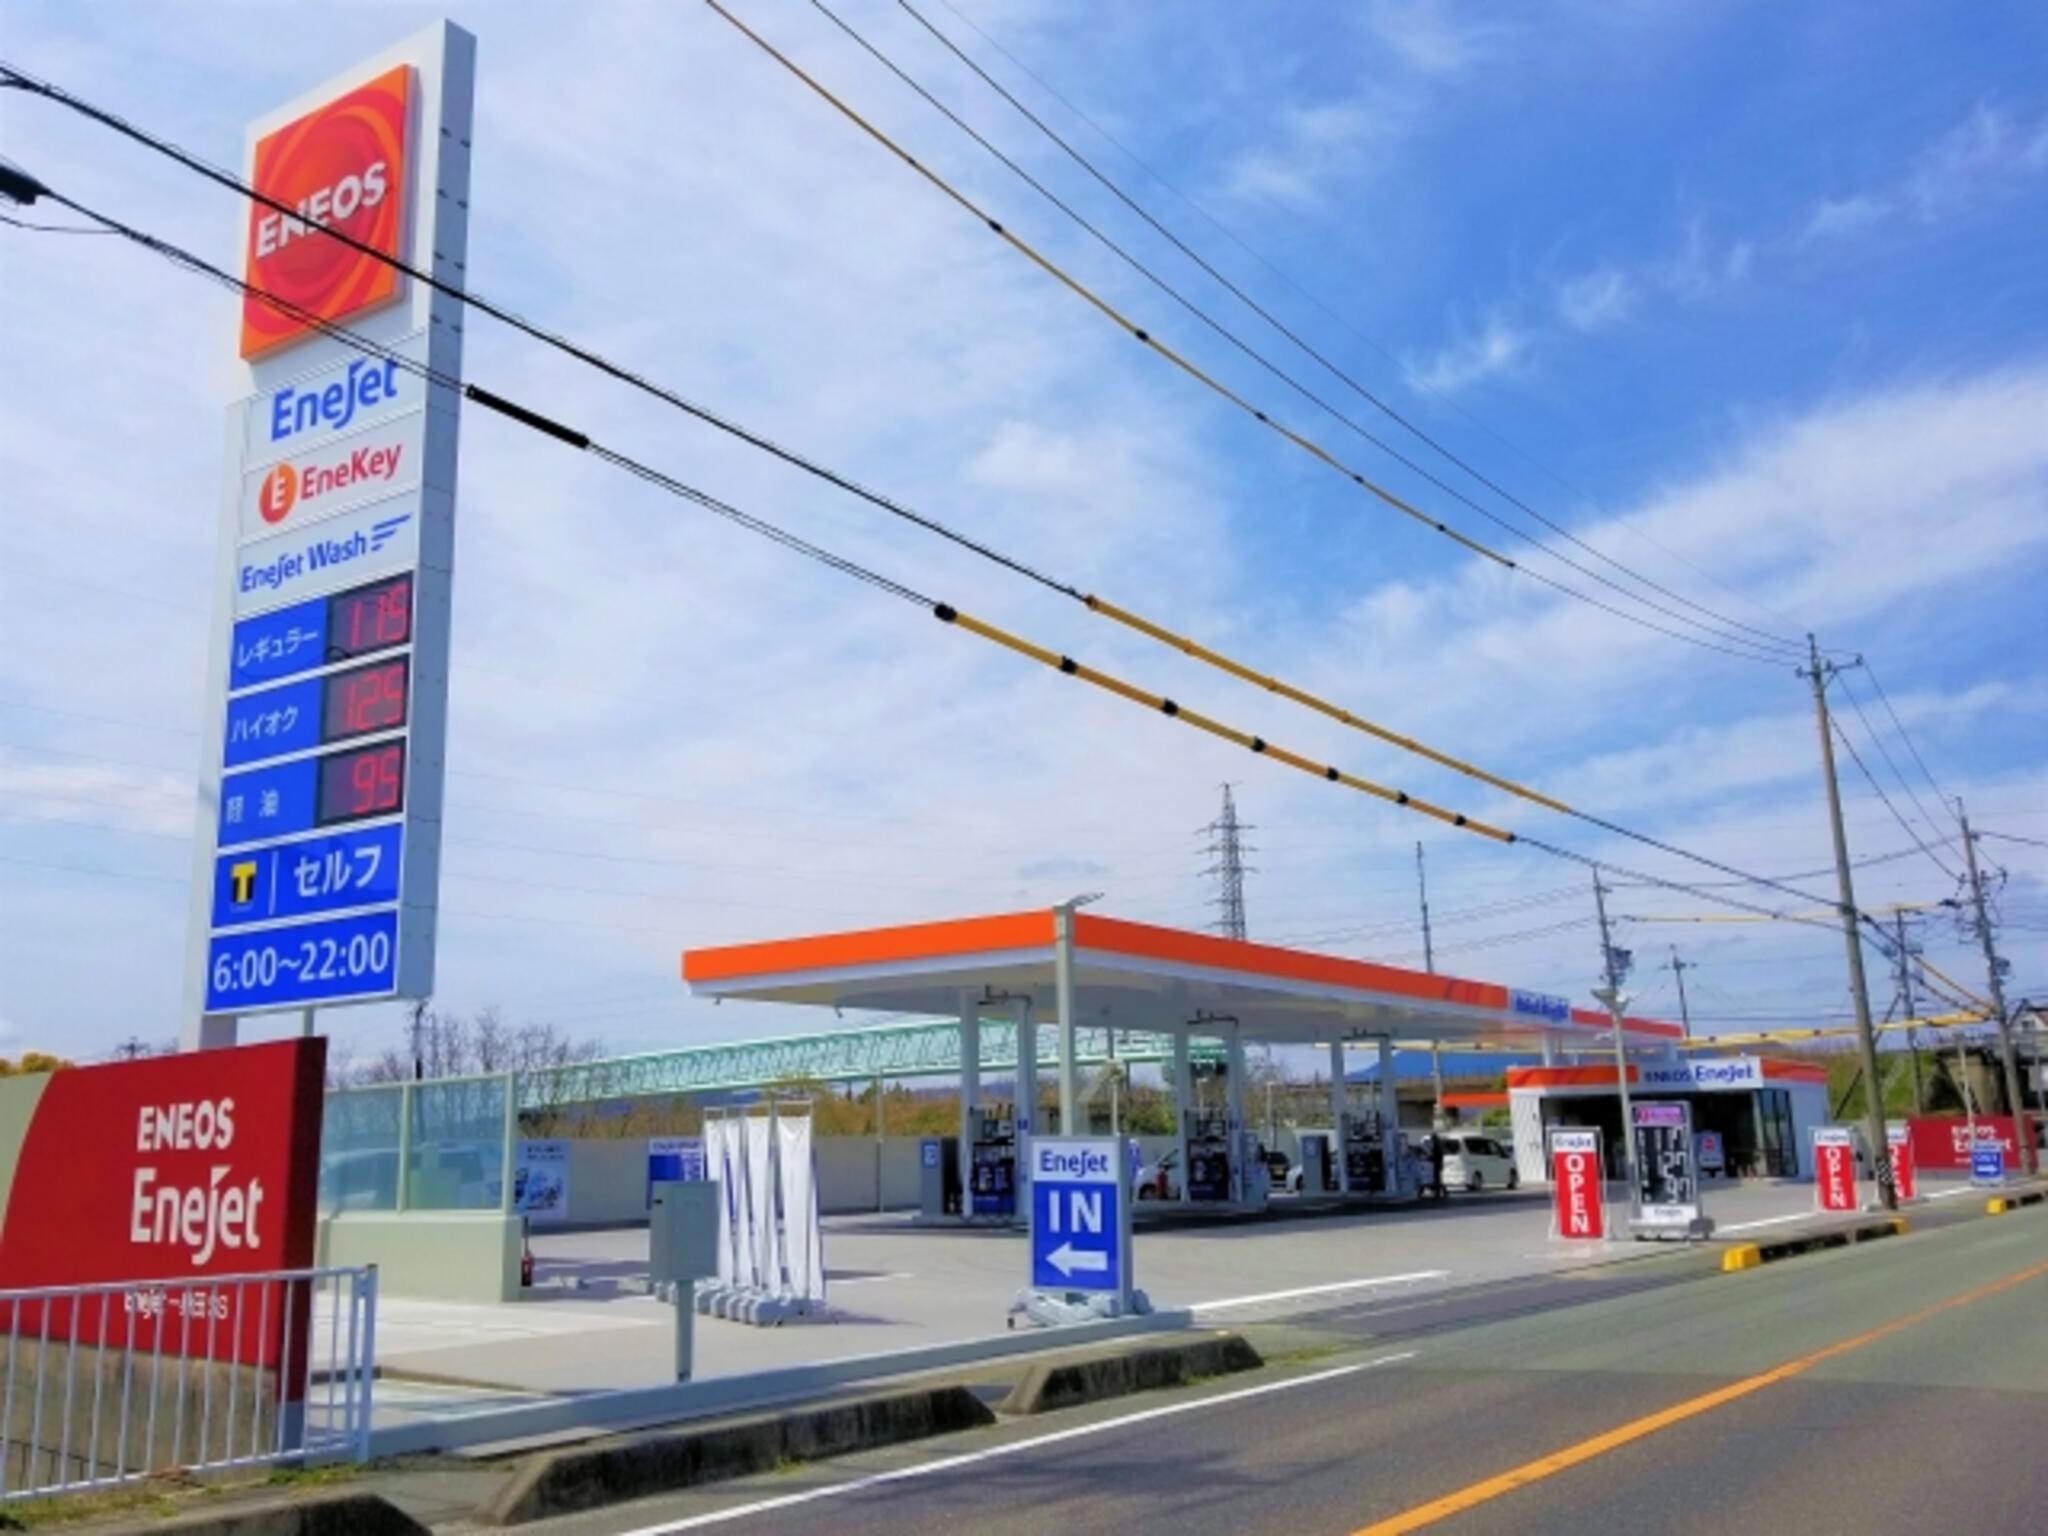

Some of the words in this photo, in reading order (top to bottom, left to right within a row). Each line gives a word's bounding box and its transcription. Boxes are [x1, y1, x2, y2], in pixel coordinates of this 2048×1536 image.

[255, 161, 386, 258] ENEOS
[272, 358, 397, 441] Enejet
[300, 445, 402, 500] EneKey
[308, 532, 367, 570] Wash
[238, 628, 319, 668] レギュラー
[231, 704, 299, 744] ハイオク
[294, 845, 382, 897] セルフ
[137, 1097, 235, 1151] ENEOS
[1040, 1149, 1108, 1178] Enejet
[1826, 1148, 1846, 1207] OPEN
[131, 1165, 263, 1265] Enejet
[1048, 1190, 1102, 1233] IN
[1565, 1154, 1589, 1233] OPEN
